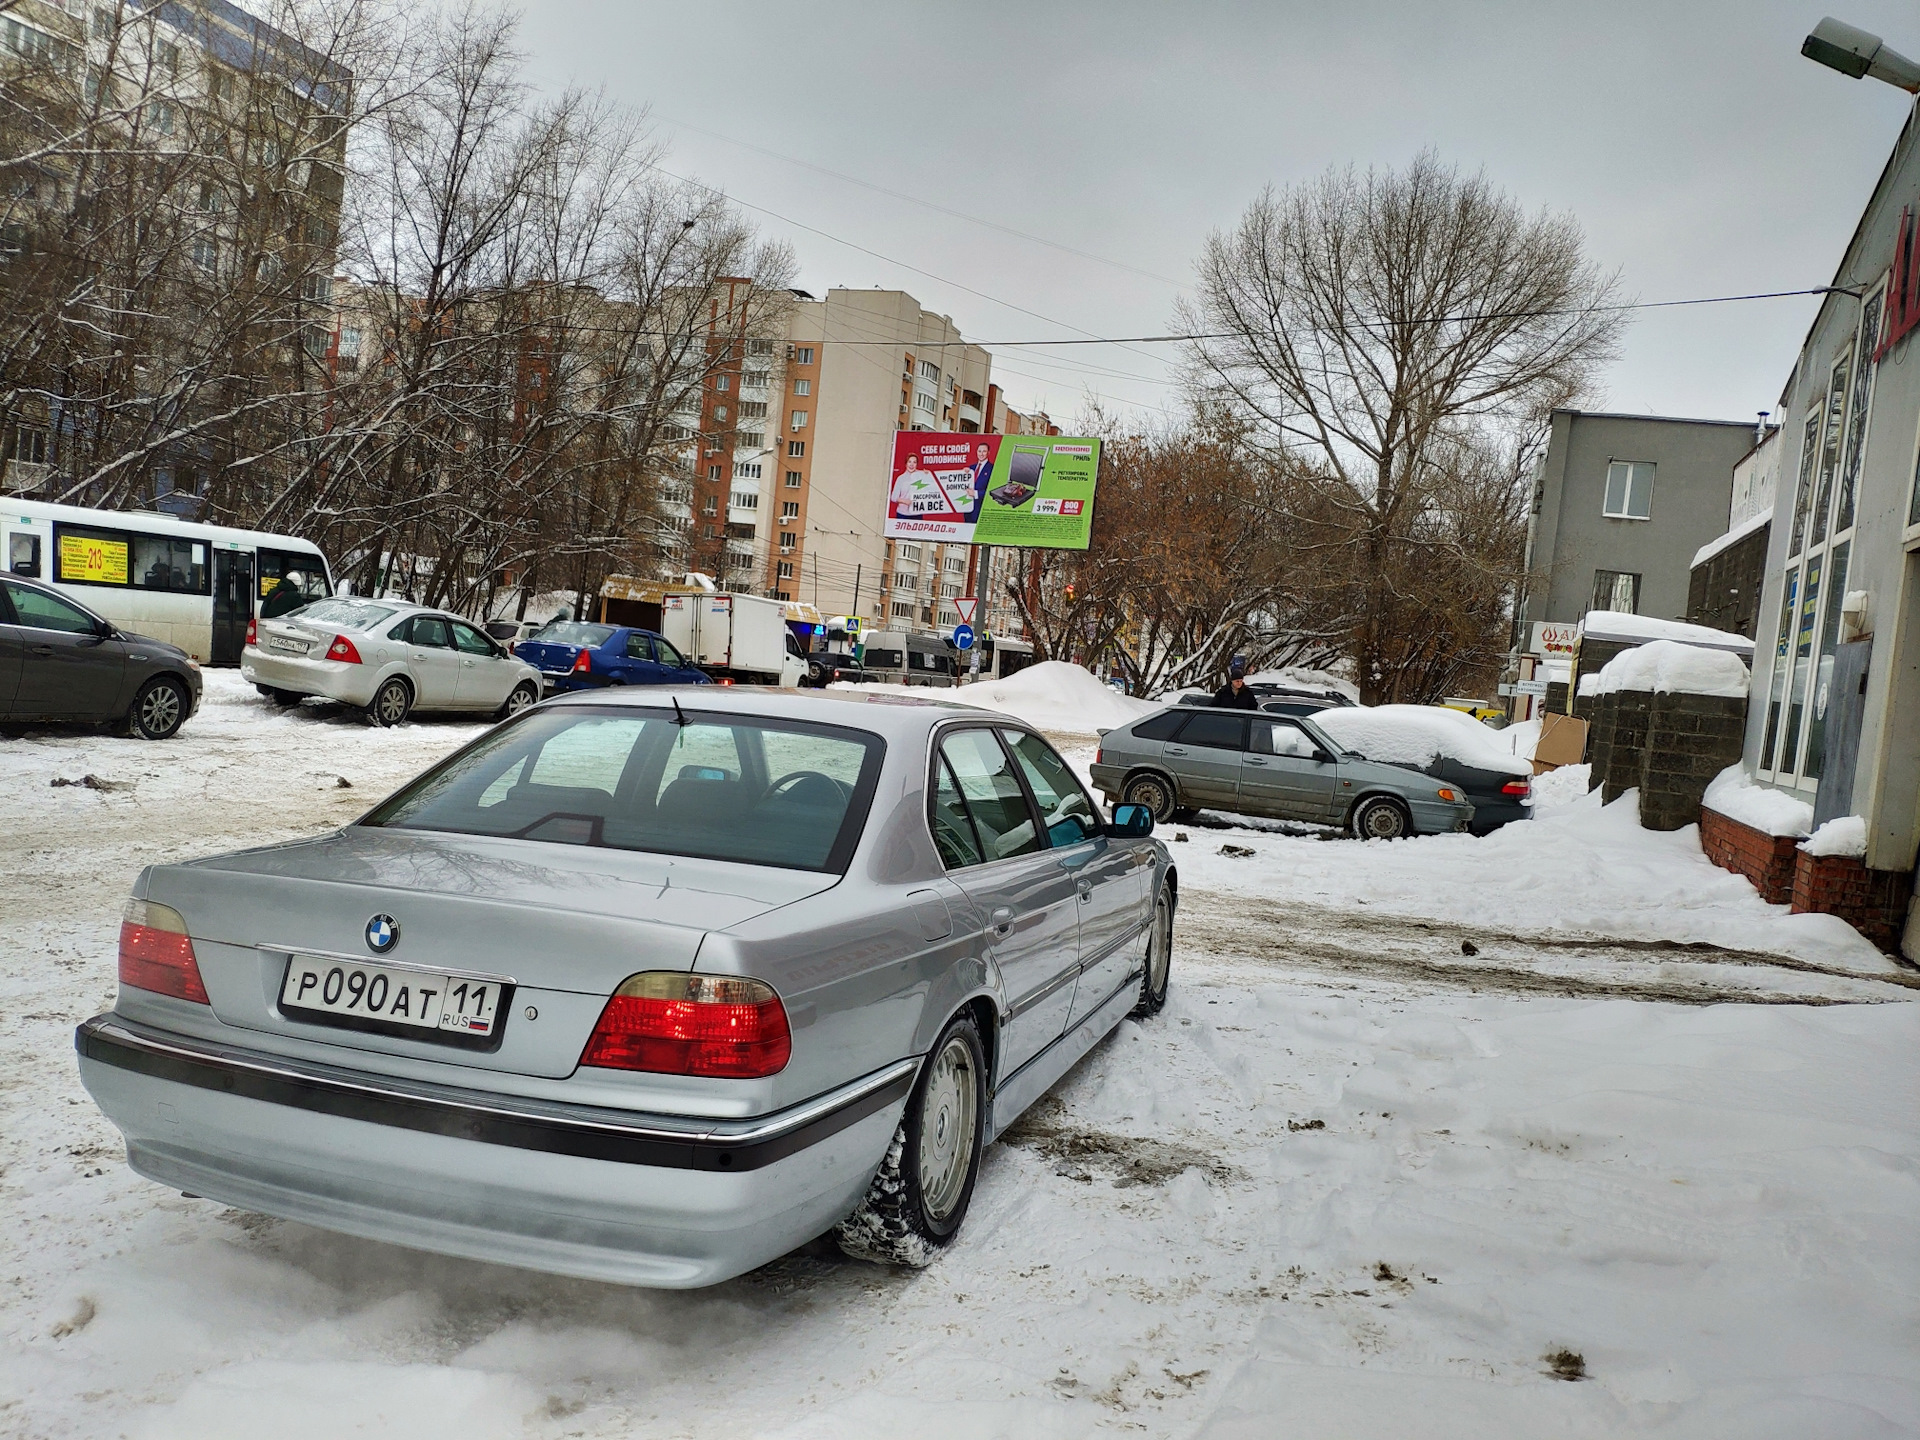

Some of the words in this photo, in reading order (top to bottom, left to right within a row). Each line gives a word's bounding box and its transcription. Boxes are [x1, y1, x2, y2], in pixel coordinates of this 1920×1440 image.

[921, 445, 938, 454] СЕБЕ
[939, 445, 945, 453] И
[946, 442, 970, 453] СВОЕЙ
[923, 455, 967, 464] ПОЛОВИНКЕ
[948, 473, 972, 482] СУПЕР
[912, 501, 925, 511] НА
[1064, 501, 1079, 509] 800
[88, 547, 103, 570] 213
[369, 914, 397, 930] BMW
[296, 967, 438, 1020] Р090АТ
[452, 983, 488, 1017] 11
[442, 1013, 469, 1028] RUS
